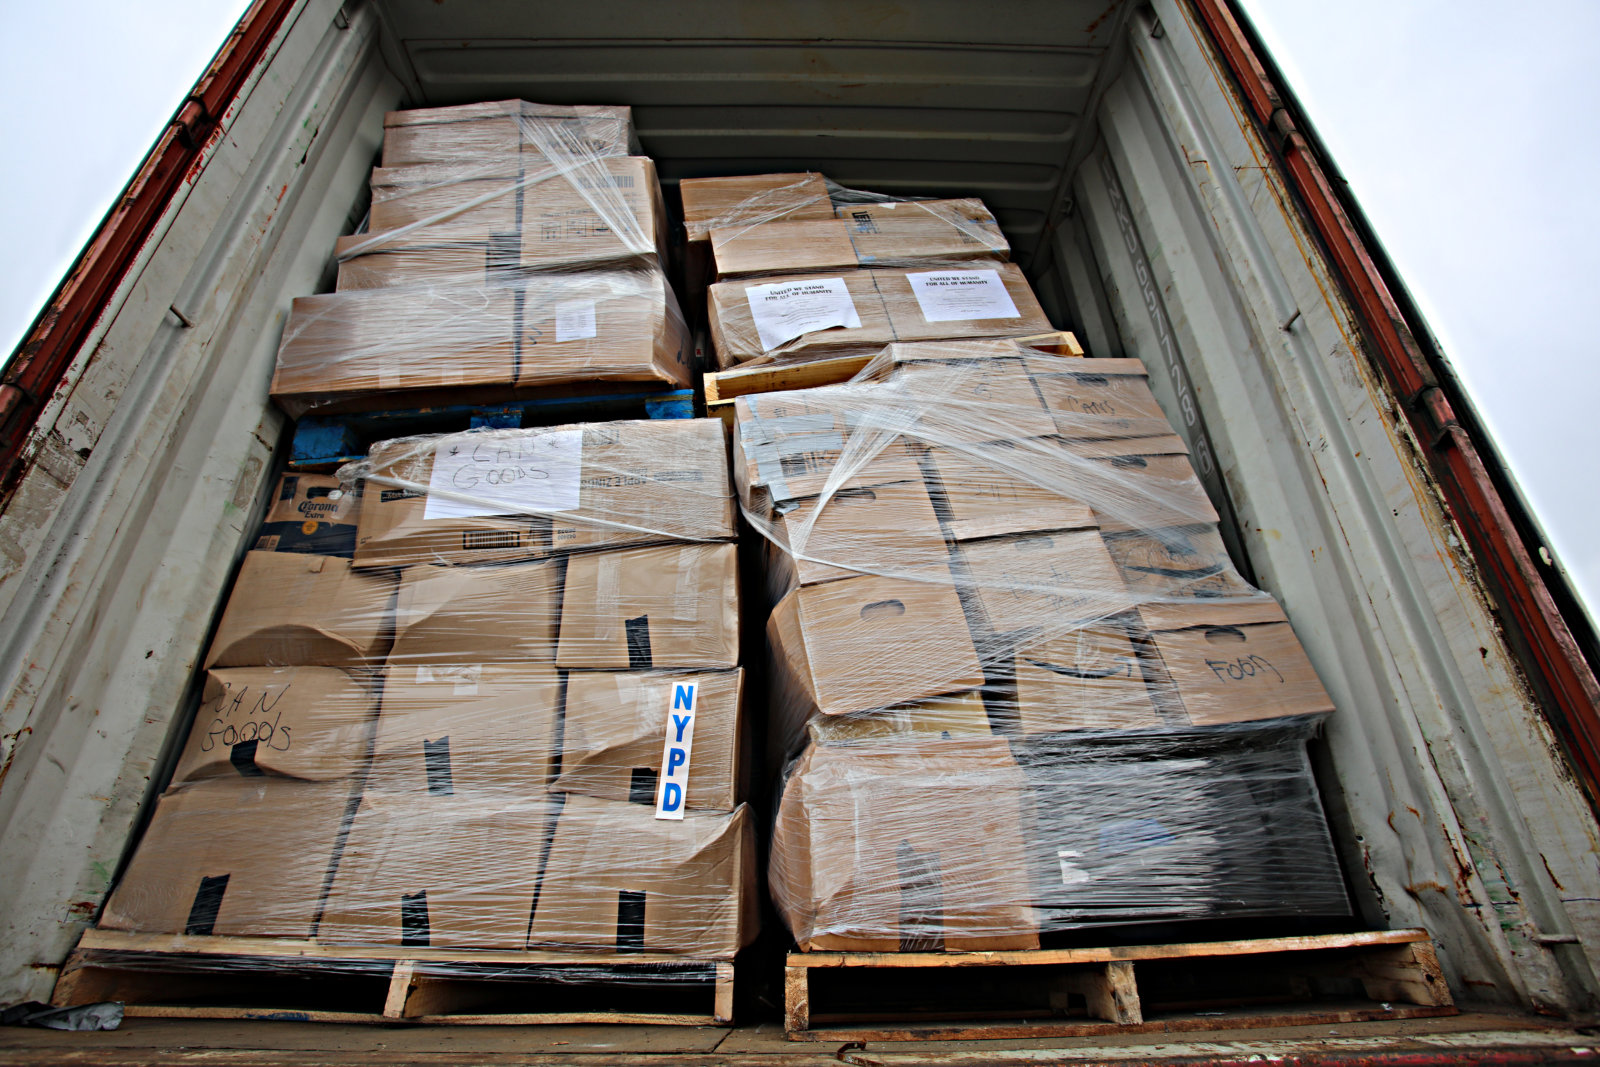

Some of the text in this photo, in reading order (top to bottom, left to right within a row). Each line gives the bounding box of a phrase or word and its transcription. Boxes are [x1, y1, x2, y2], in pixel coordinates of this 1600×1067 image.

[769, 286, 792, 296] UNITED
[801, 288, 833, 296] HUMANITY
[1134, 257, 1196, 428] 657728
[297, 500, 339, 513] Corona
[304, 509, 325, 519] Extra
[214, 681, 291, 718] CAN
[662, 684, 694, 812] NYPD
